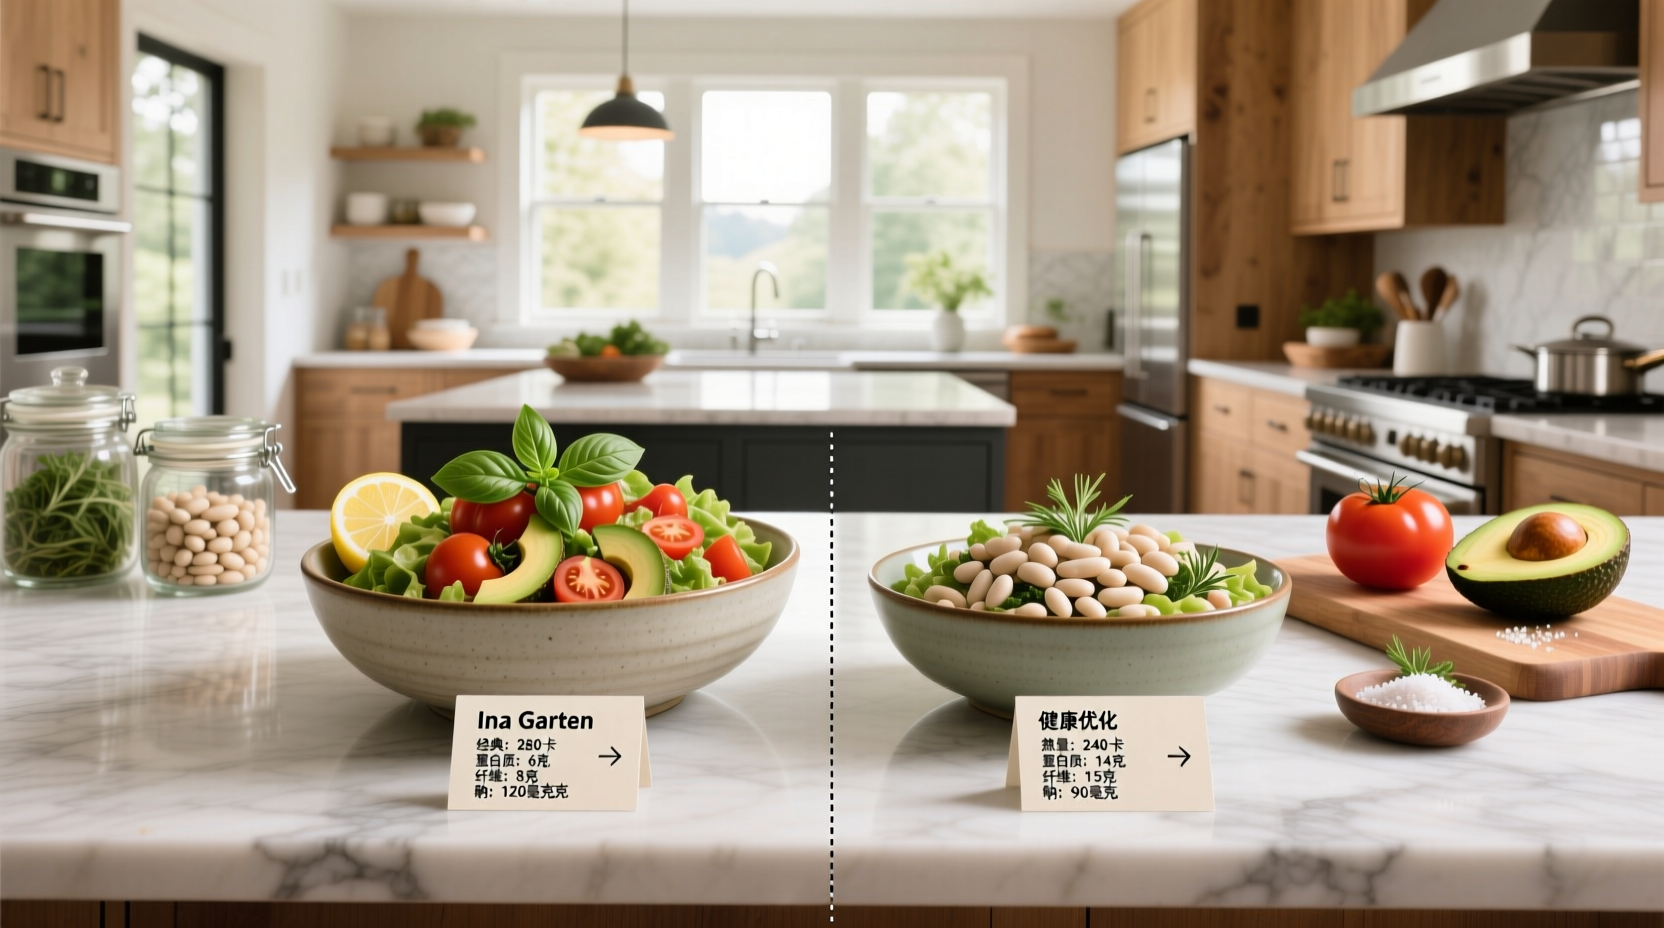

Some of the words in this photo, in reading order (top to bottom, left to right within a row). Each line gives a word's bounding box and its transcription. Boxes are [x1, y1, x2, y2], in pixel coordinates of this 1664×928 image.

[478, 711, 511, 730] Ina
[518, 711, 593, 730] Garten
[1038, 710, 1118, 731] 健康优化
